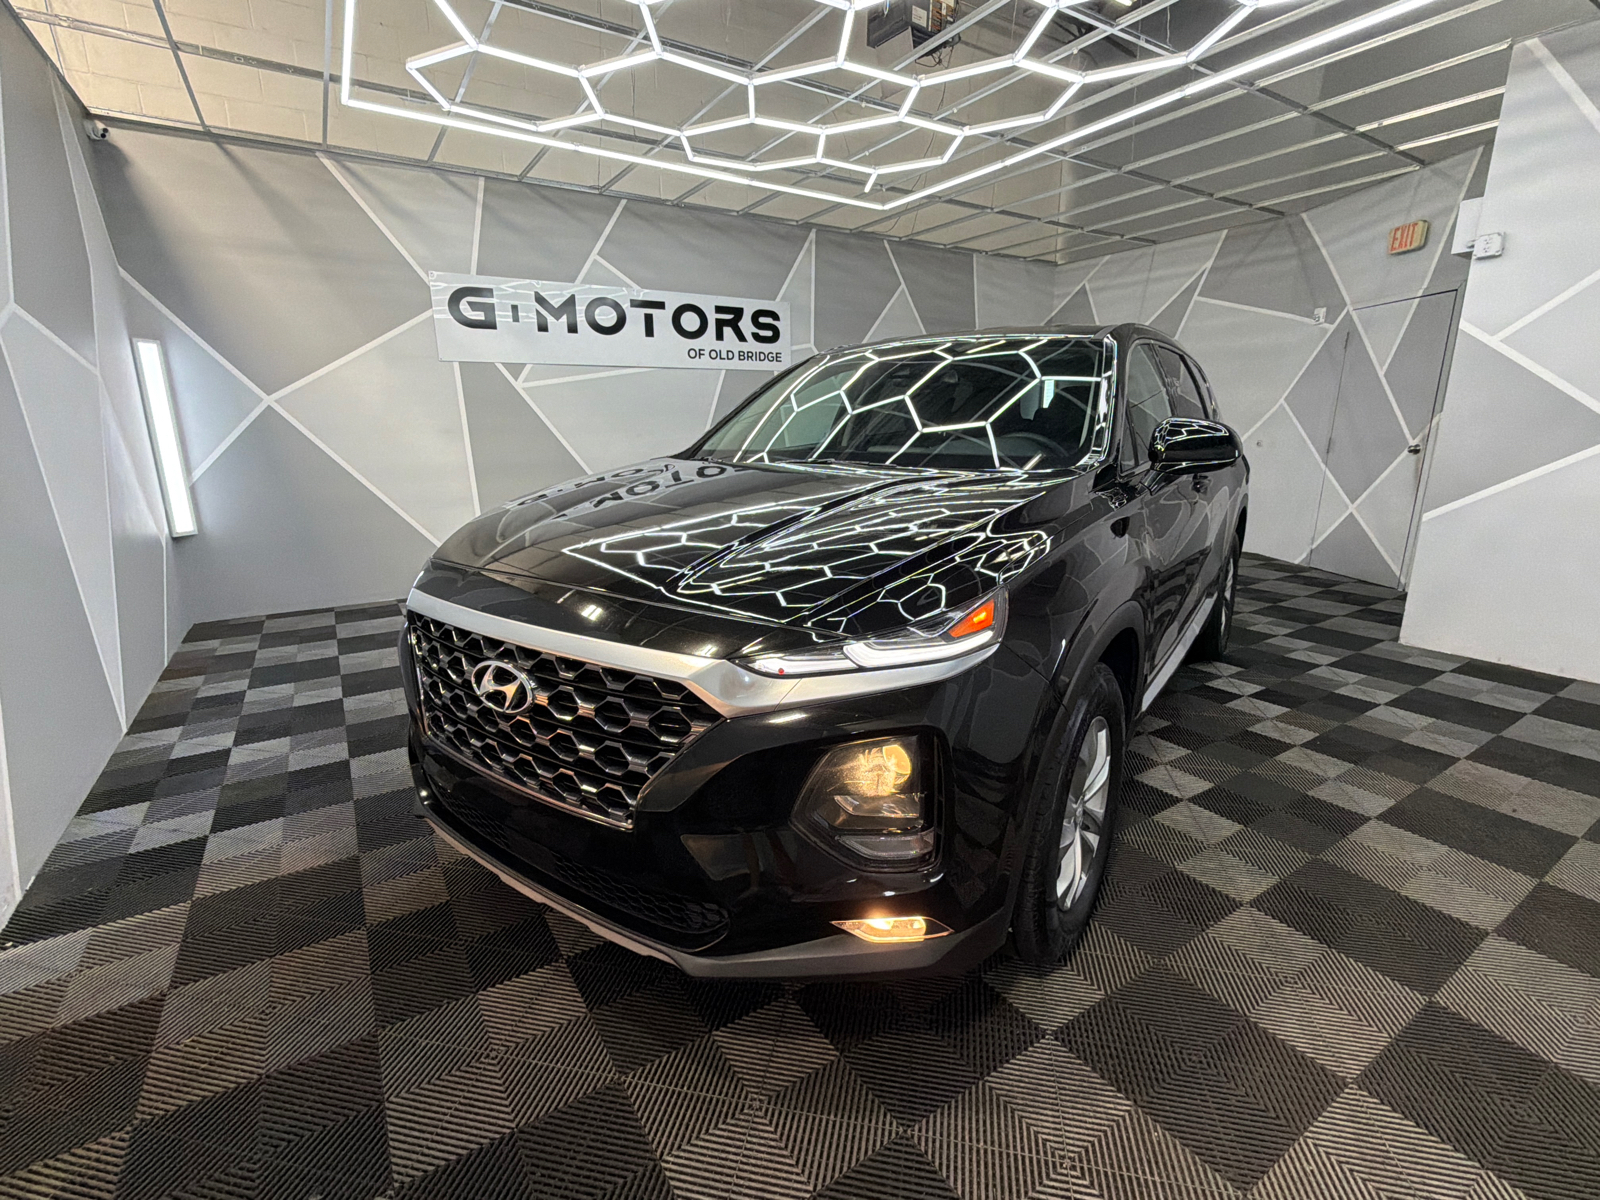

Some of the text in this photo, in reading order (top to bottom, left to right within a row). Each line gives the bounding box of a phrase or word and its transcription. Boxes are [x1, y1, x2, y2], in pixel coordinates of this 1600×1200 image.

[1390, 222, 1419, 252] EXIT
[687, 347, 783, 363] OF OLD BRIDGE
